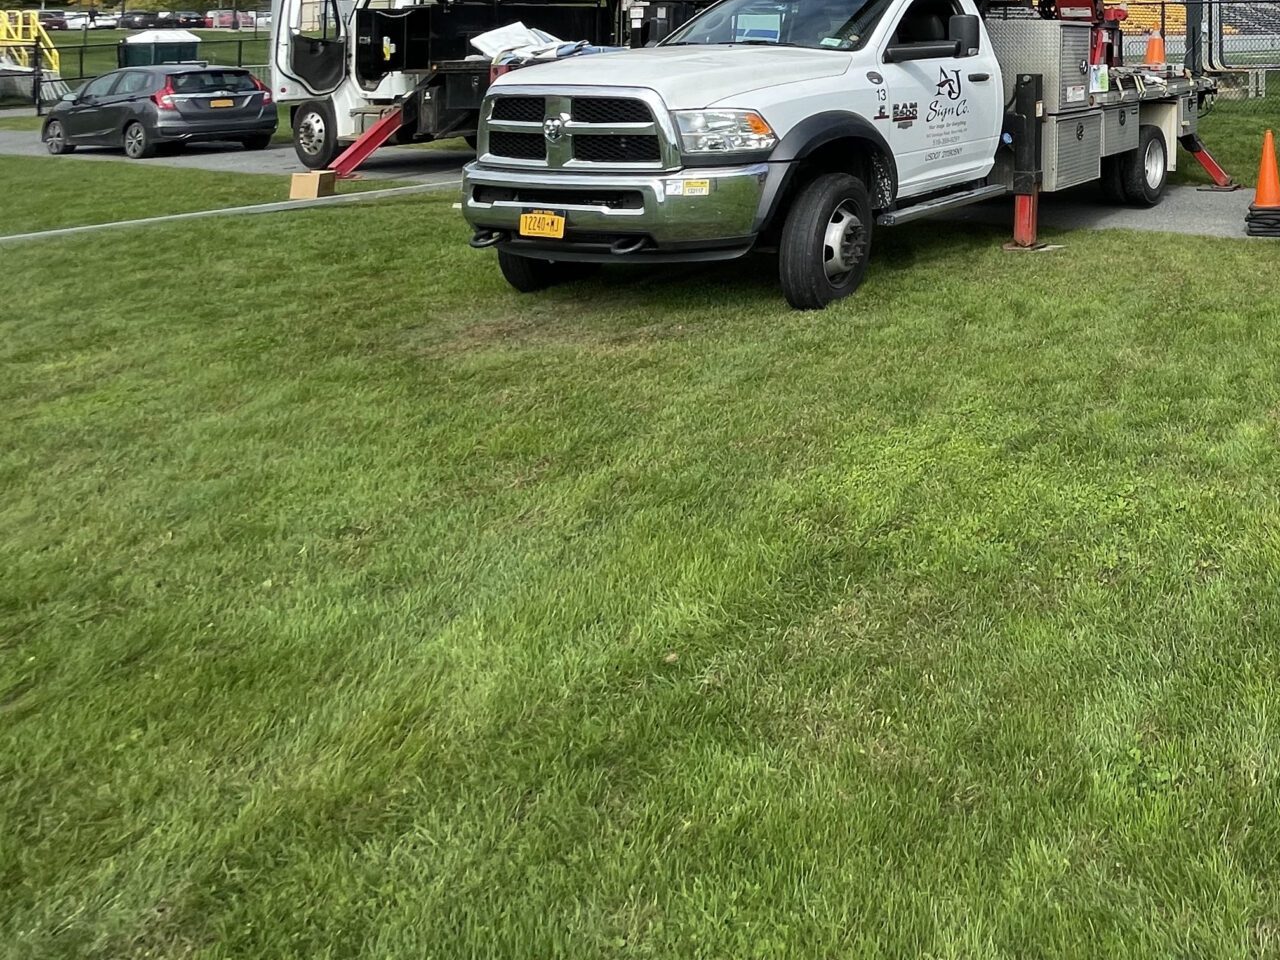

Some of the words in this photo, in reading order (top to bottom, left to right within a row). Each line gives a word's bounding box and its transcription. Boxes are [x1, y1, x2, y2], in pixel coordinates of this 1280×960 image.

[934, 66, 962, 101] AJ
[876, 88, 887, 102] 13
[892, 102, 918, 111] RAM
[892, 109, 918, 118] 5500
[926, 100, 954, 123] Sign
[955, 99, 970, 117] Co.
